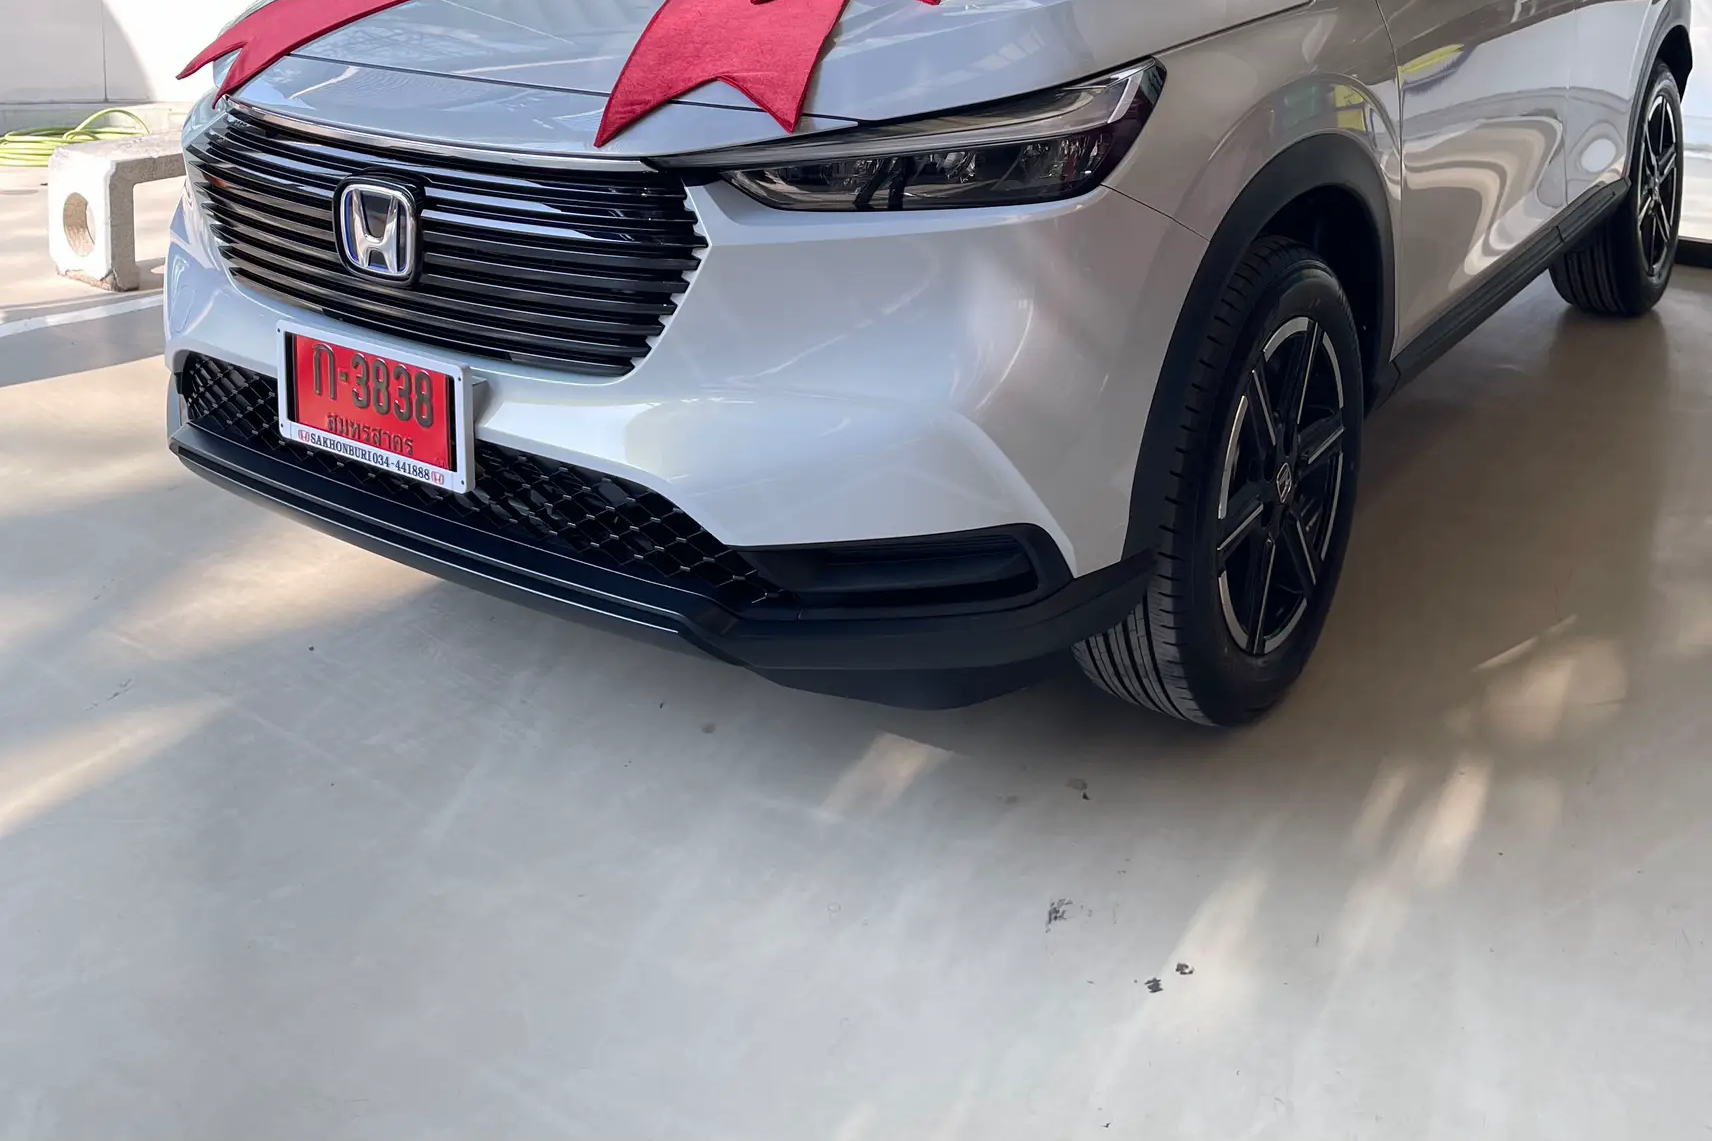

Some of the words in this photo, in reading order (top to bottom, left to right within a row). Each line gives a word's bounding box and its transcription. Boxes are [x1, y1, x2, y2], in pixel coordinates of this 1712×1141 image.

[313, 342, 435, 429] ก-3838
[310, 432, 373, 463] SAKHONBURI
[372, 453, 431, 482] 034-441888
